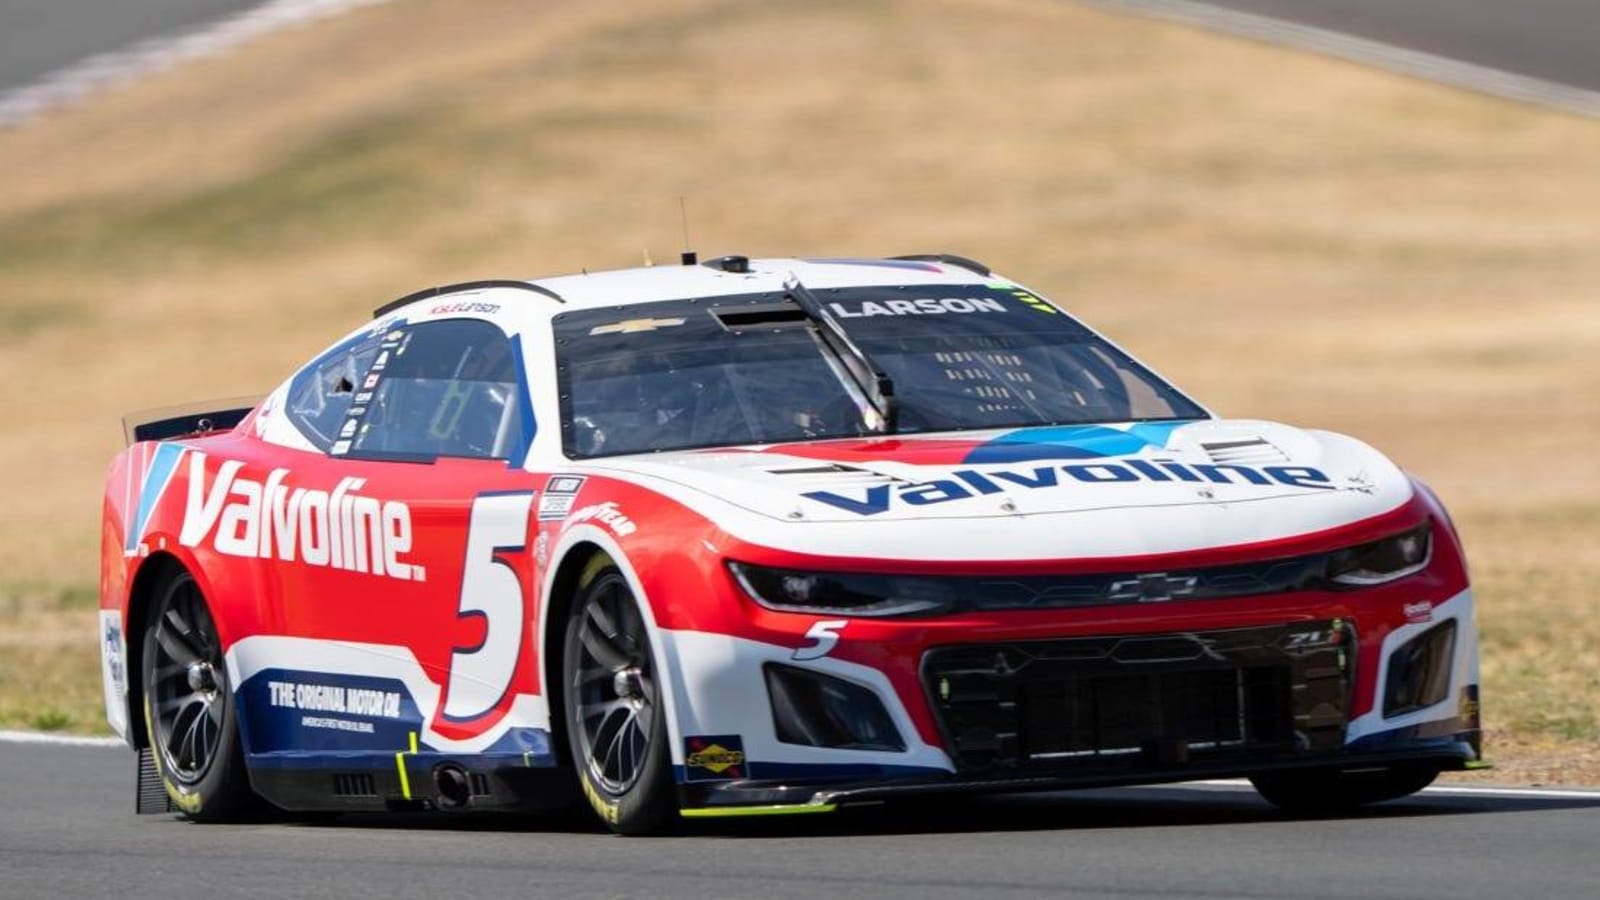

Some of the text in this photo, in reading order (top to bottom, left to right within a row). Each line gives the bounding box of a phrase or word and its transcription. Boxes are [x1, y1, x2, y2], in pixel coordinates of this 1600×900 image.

[830, 298, 1008, 318] LARSON
[803, 457, 1337, 516] Valvoline
[181, 450, 413, 580] Valvoline
[441, 490, 534, 724] 5
[791, 620, 849, 661] 5
[268, 681, 401, 718] THE ORIGINAL MOTOR OIL
